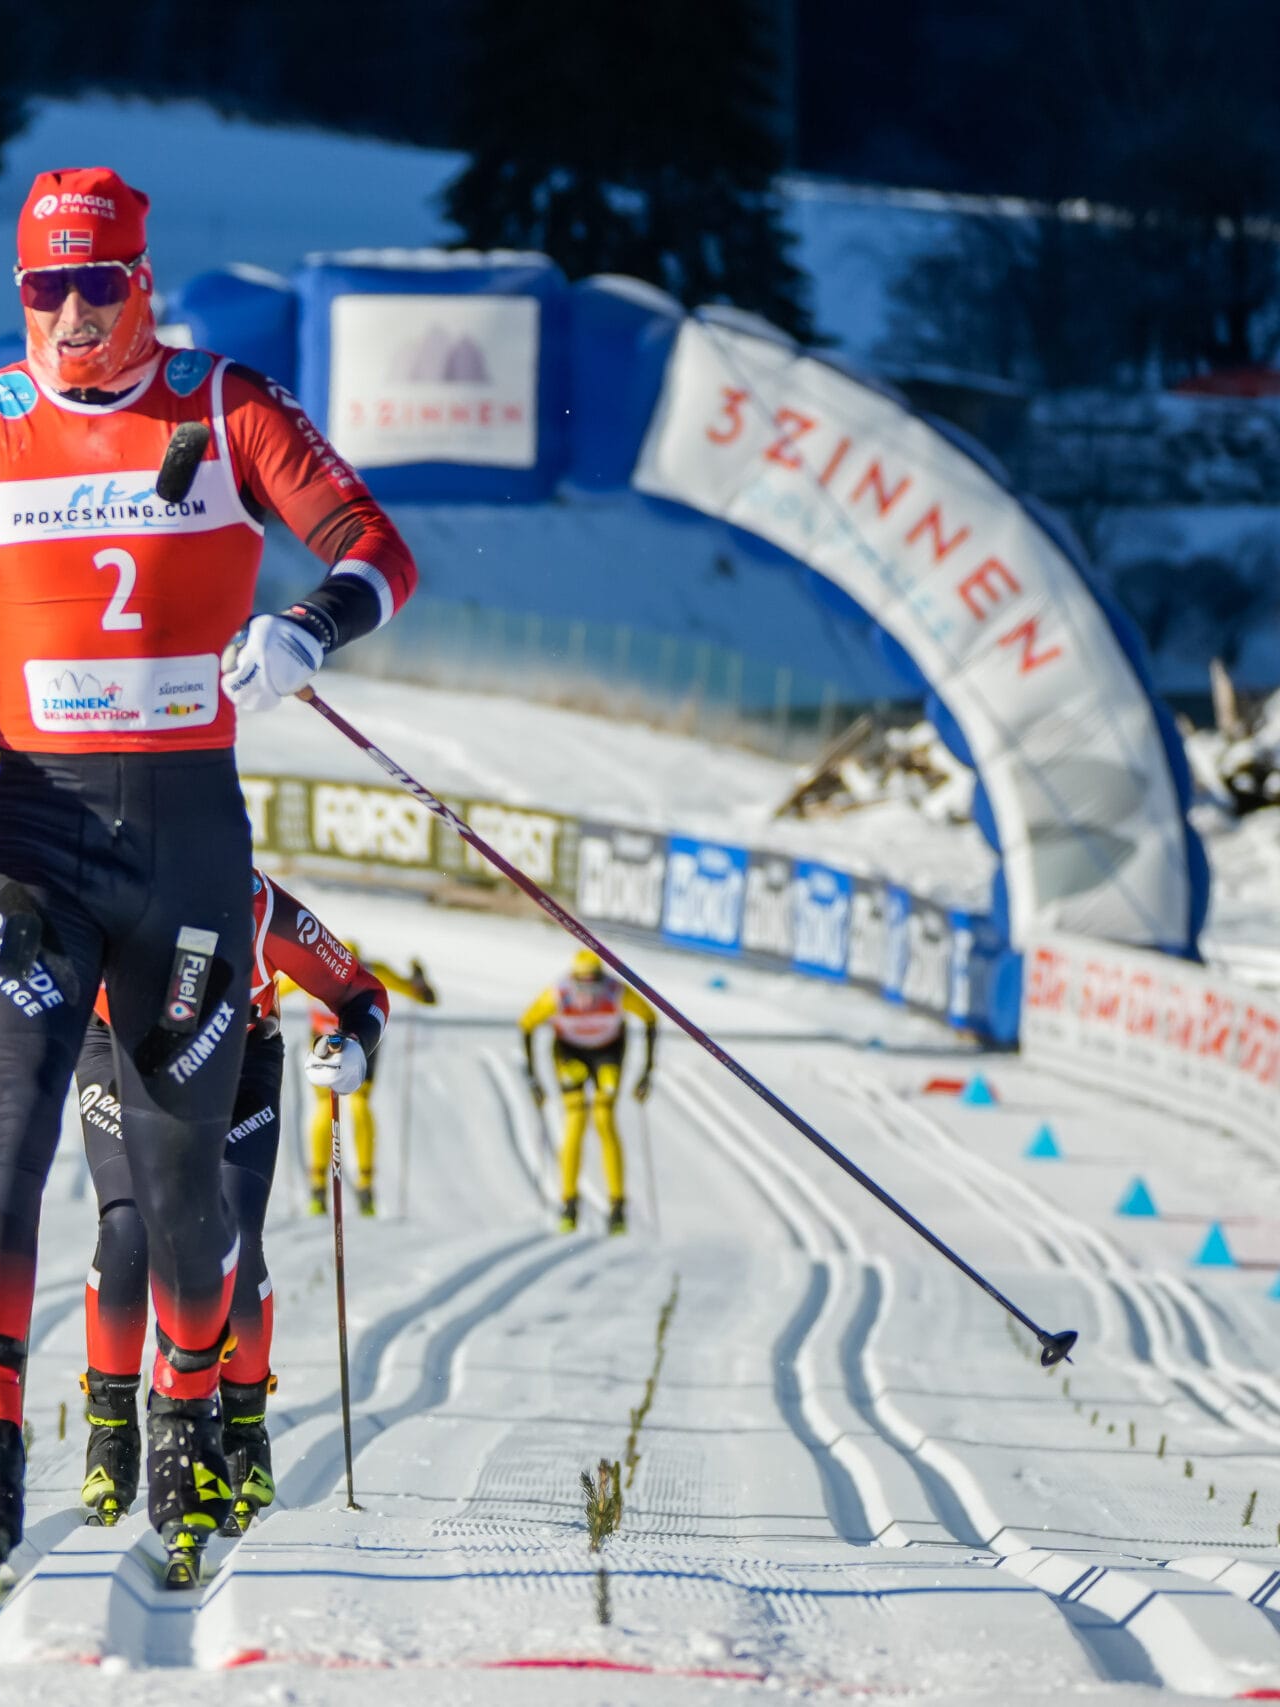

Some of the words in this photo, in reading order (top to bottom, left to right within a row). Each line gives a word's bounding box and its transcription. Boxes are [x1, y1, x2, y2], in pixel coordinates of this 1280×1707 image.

[59, 204, 116, 219] CHARGE
[61, 192, 114, 209] RAGDE
[13, 499, 207, 527] PROXCSKIING.COM
[705, 384, 751, 445] 3
[762, 407, 1064, 677] ZINNEN
[92, 547, 144, 631] 2
[51, 696, 110, 710] ZINNEN
[316, 943, 350, 980] CHARGE
[321, 925, 353, 967] RAGDE
[177, 953, 206, 1005] Fuel
[168, 1001, 235, 1086] TRIMTEX
[225, 1106, 276, 1144] TRIMTEX
